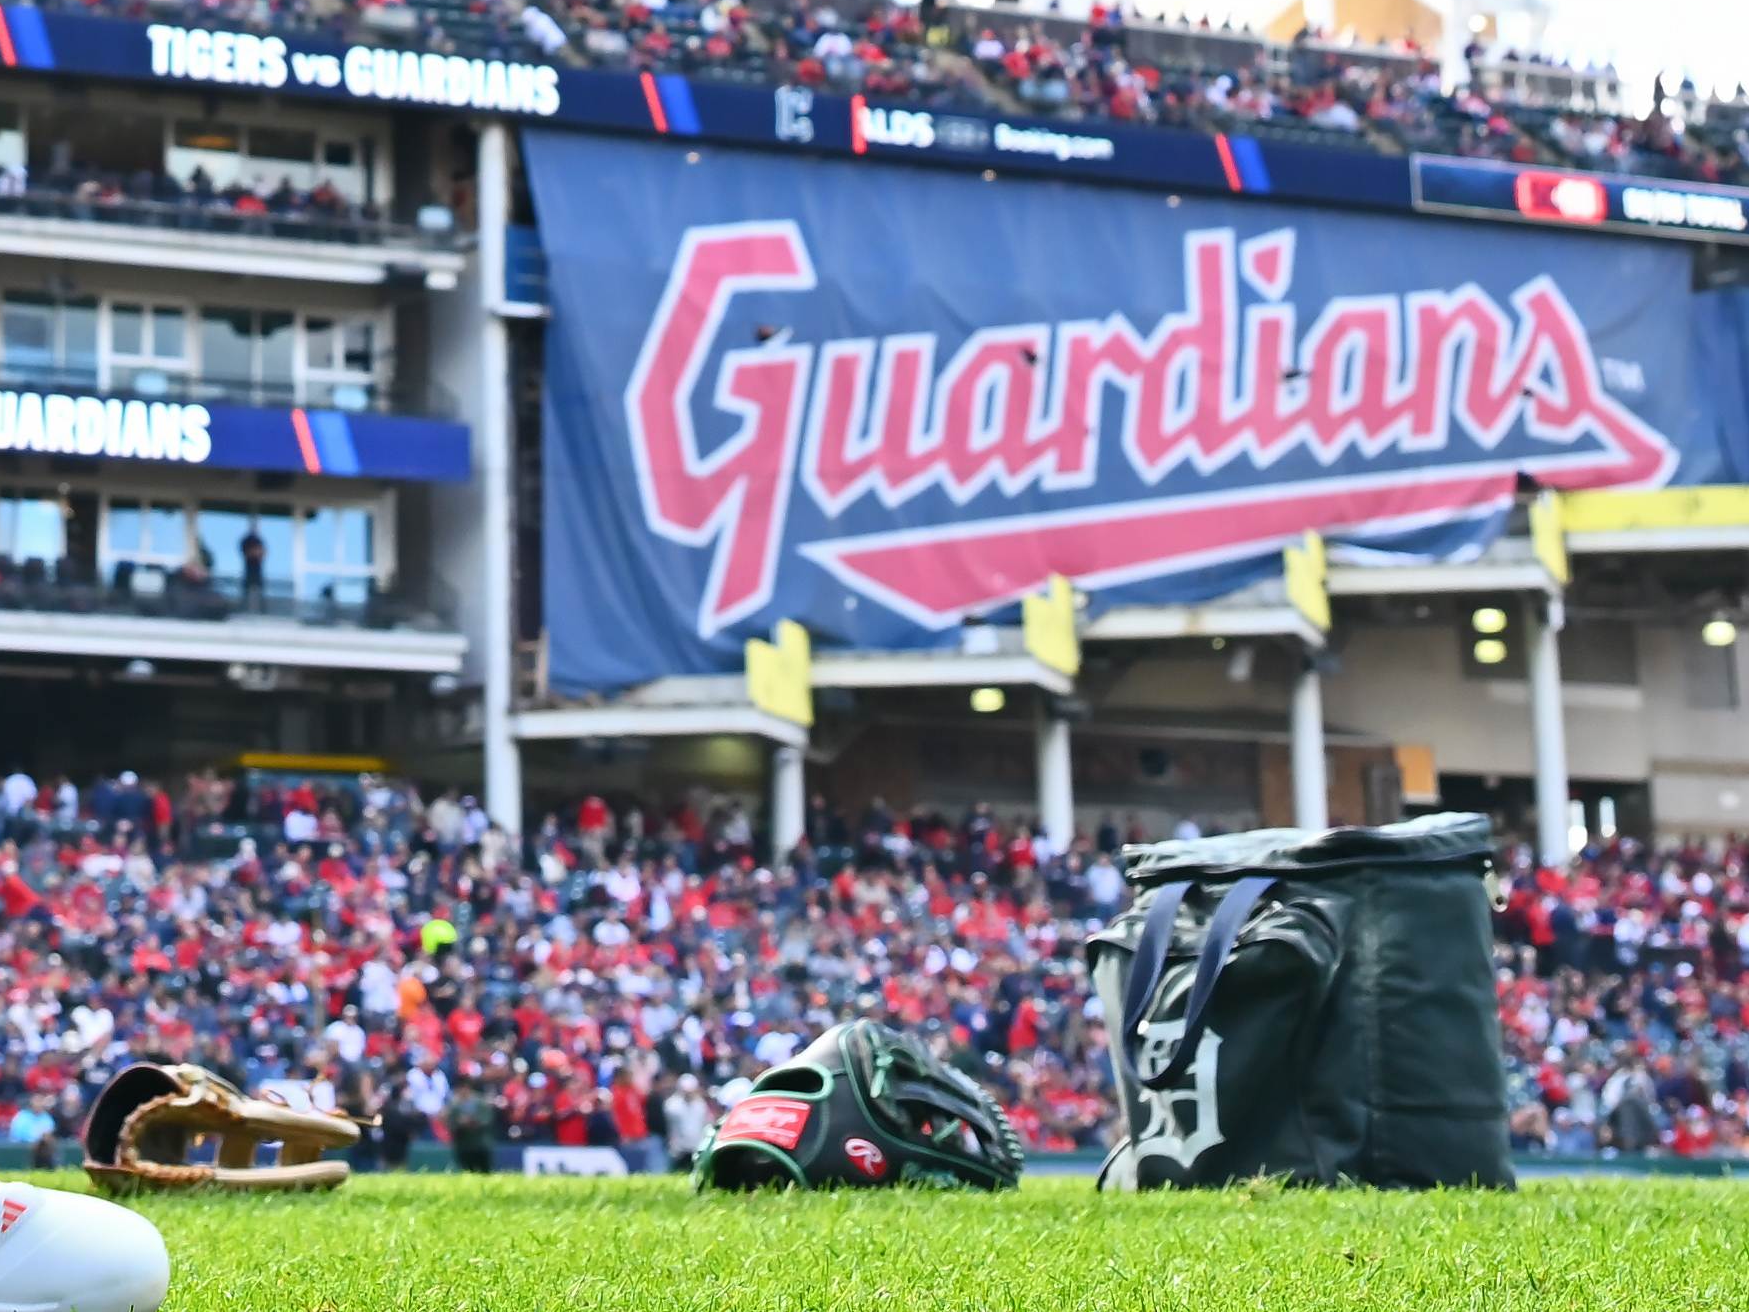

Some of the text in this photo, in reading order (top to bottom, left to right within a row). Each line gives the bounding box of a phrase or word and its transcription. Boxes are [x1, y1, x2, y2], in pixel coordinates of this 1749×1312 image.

[148, 24, 560, 117] TIGERS vs GUARDIANS
[624, 217, 1597, 639] Guardians
